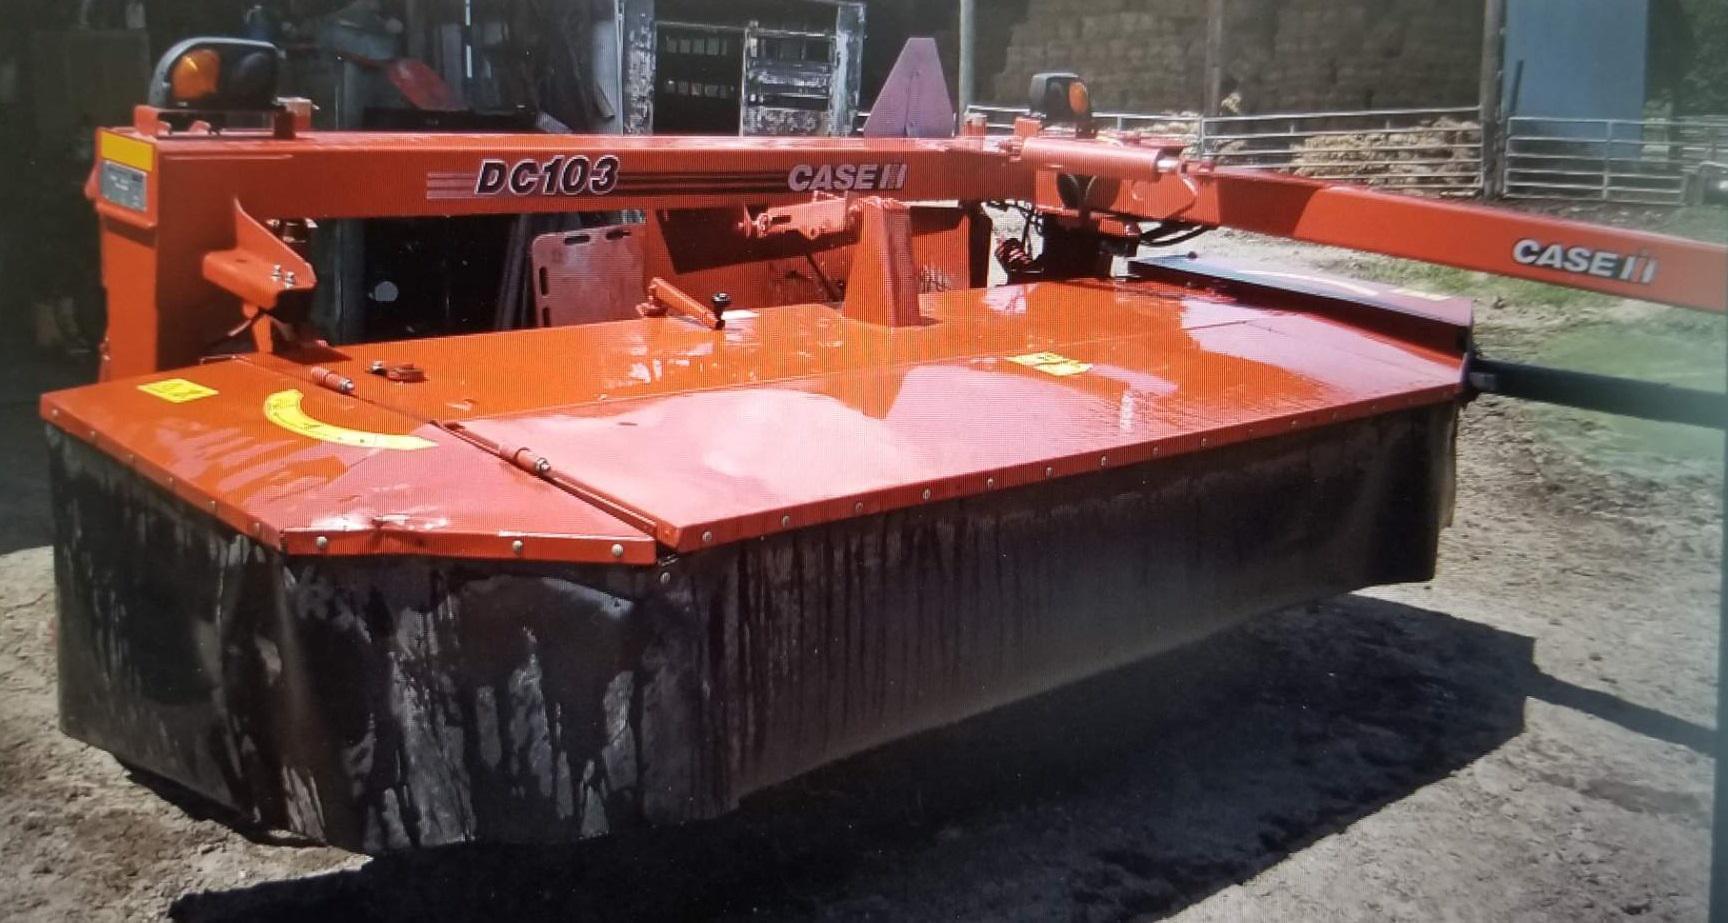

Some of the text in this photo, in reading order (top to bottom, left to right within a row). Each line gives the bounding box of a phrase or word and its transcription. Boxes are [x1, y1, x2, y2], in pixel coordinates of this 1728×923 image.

[474, 154, 620, 195] DC103
[787, 163, 878, 191] CASE
[1513, 238, 1618, 277] CASE
